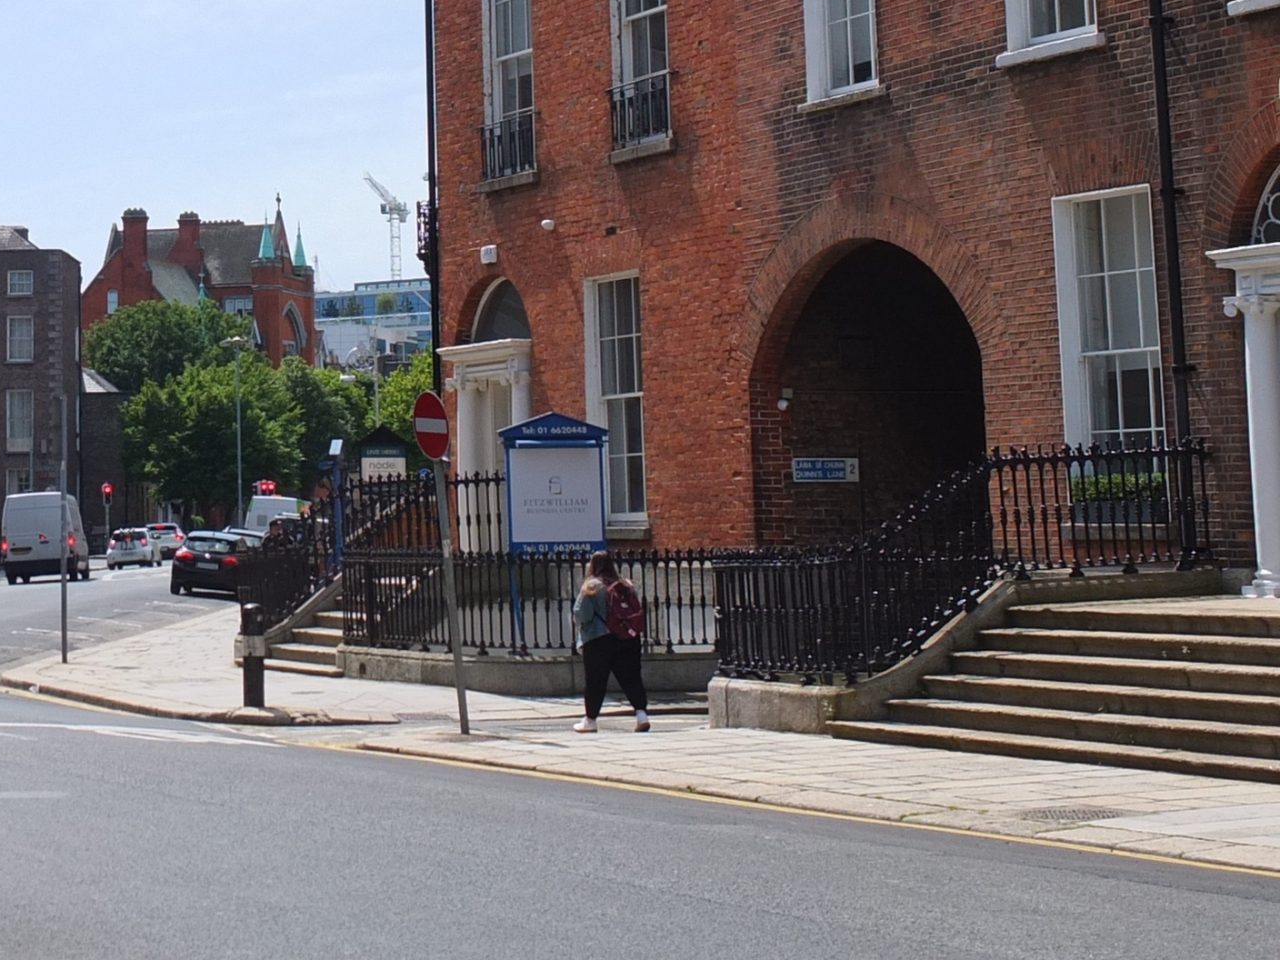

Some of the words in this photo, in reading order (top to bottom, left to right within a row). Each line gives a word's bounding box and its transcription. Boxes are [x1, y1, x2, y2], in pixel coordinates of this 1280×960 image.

[537, 426, 548, 434] 01
[849, 463, 856, 475] 2
[523, 498, 589, 507] FITZWILLIAM
